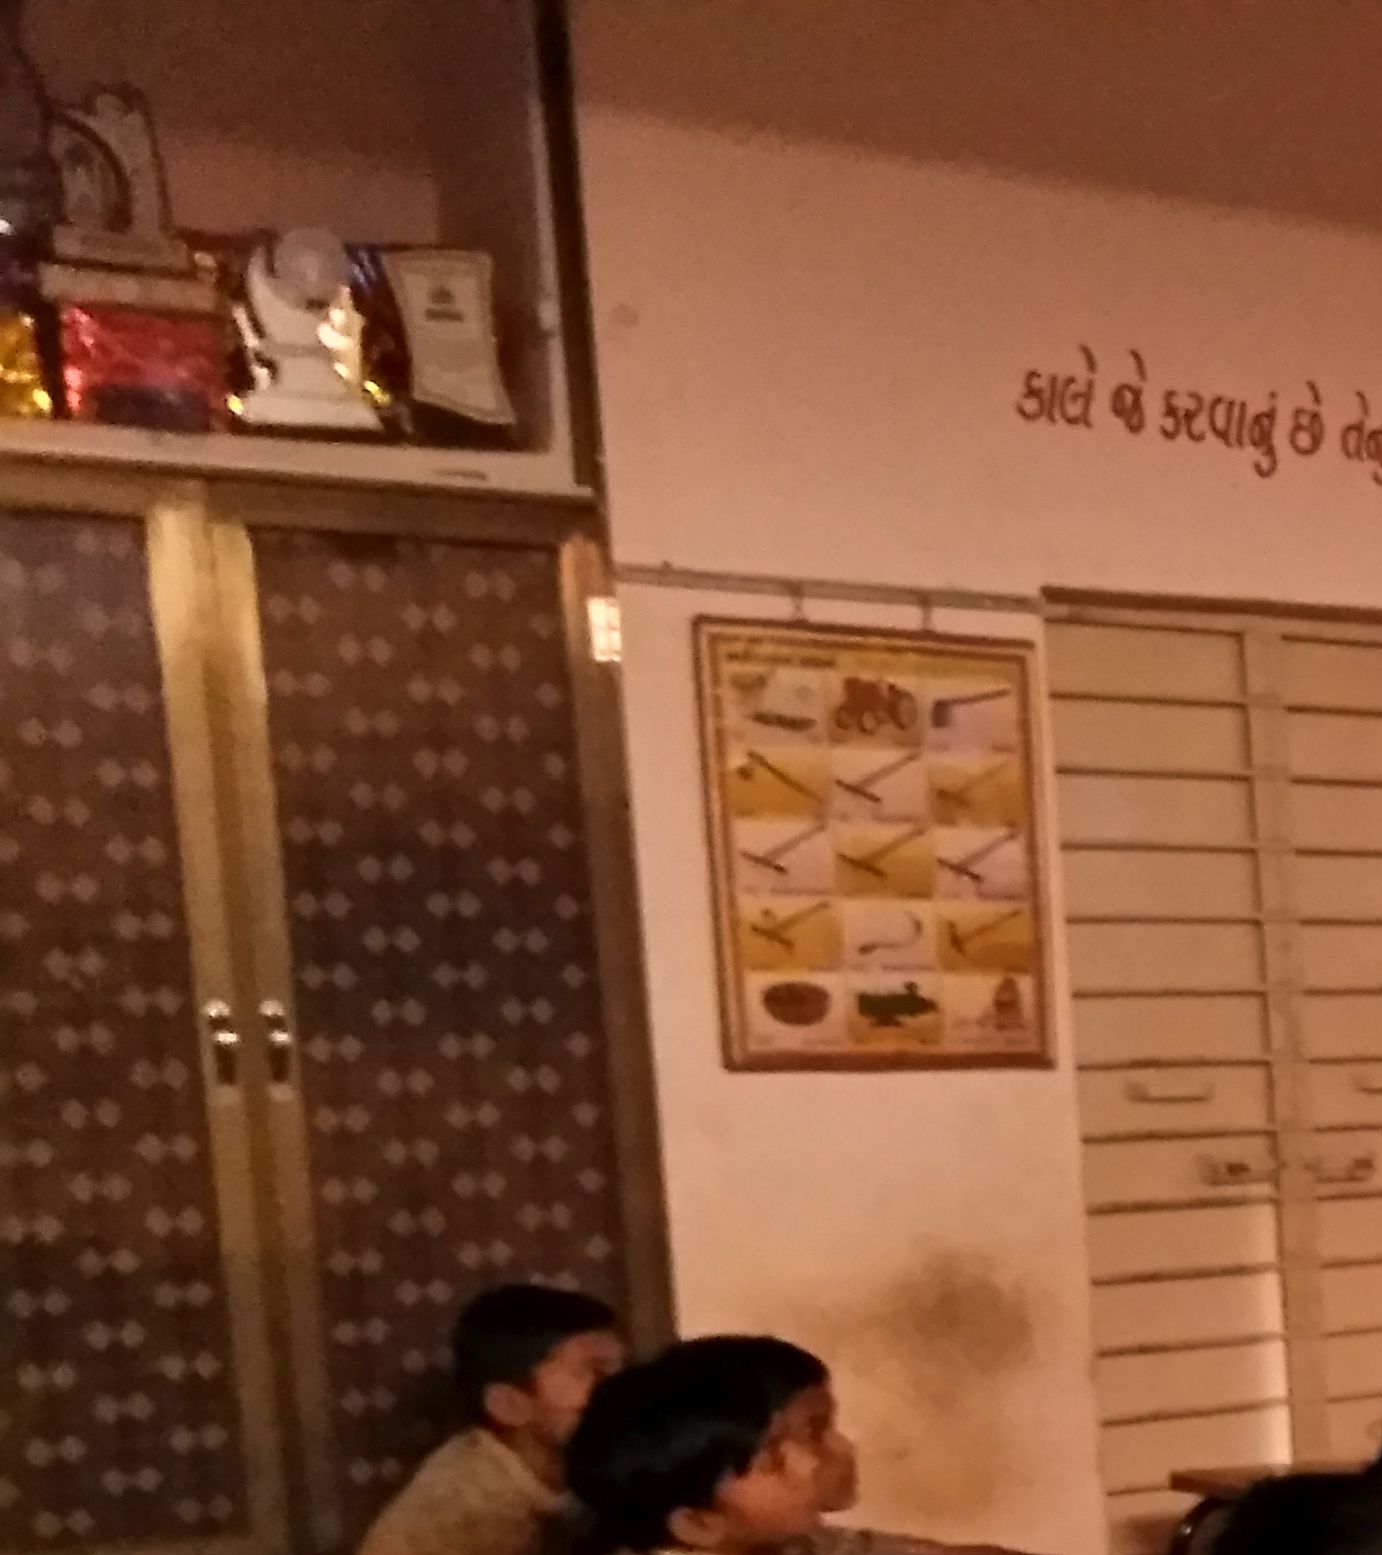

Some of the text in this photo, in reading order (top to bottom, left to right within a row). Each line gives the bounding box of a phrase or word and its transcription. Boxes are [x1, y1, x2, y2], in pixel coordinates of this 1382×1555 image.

[1016, 342, 1096, 428] કાલે
[1160, 390, 1279, 478] કરવાનું
[1289, 380, 1325, 456] છે
